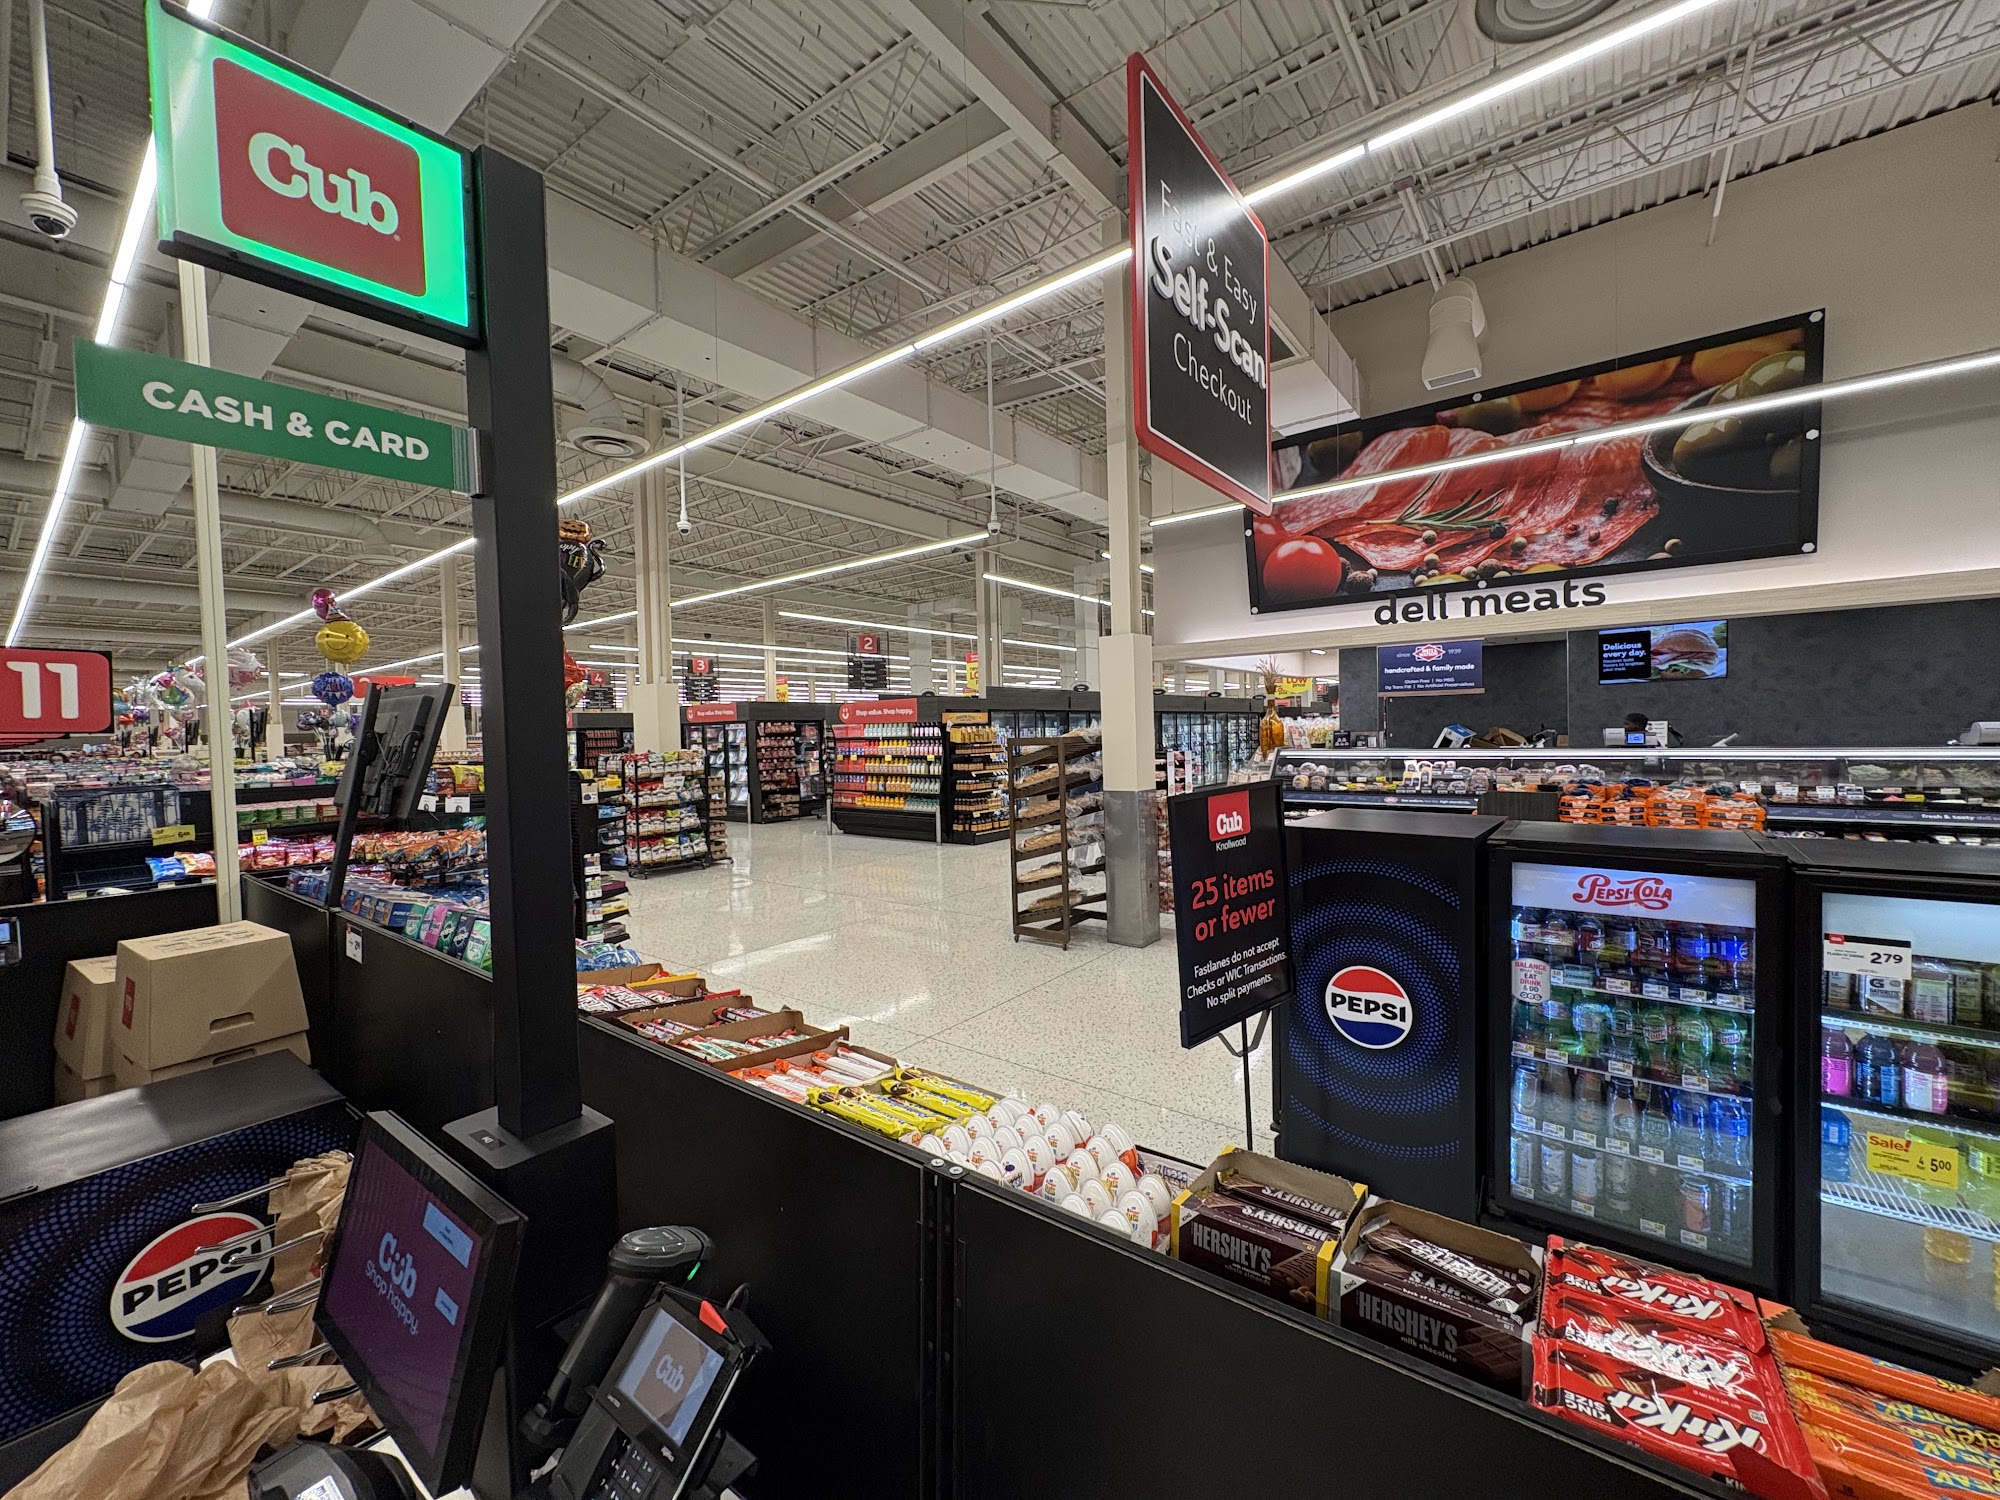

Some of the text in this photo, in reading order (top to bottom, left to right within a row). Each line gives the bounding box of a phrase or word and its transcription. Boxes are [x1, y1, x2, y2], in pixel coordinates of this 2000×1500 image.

[247, 131, 399, 235] Cub
[1160, 179, 1257, 325] Fast & Easy
[1152, 235, 1266, 389] Self-Scan
[1173, 332, 1252, 425] Checkout
[141, 380, 430, 462] CASH & CARD
[1374, 580, 1606, 625] deli meats
[864, 638, 873, 650] 2
[595, 674, 603, 682] 4
[696, 660, 705, 670] 3
[1384, 665, 1424, 674] handcrafted
[6, 661, 79, 719] 11
[322, 682, 346, 692] PARTY
[1216, 811, 1243, 834] Cub
[1216, 836, 1246, 851] Knollwood
[1192, 870, 1274, 910] 25 items
[1195, 898, 1275, 941] or fewer
[1194, 937, 1280, 978] Fastlanes do not accept
[1515, 961, 1547, 971] BALANCE
[1869, 952, 1903, 964] 279
[1187, 951, 1287, 999] Checks or WIC Transactions.
[1206, 973, 1273, 1009] No split payments.
[1331, 992, 1406, 1022] PEPSI
[1869, 1135, 1911, 1152] Sale!
[1919, 1156, 1924, 1165] 4
[1930, 1158, 1951, 1172] 500
[1261, 1186, 1345, 1219] HERSHEY'S
[1182, 1213, 1192, 1222] KING
[1242, 1205, 1330, 1242] HERSHEY'S
[1193, 1222, 1272, 1274] HERSHEY'S
[365, 1260, 387, 1296] Shop
[1344, 1280, 1357, 1291] KING
[1564, 1279, 1602, 1294] KING
[1565, 1272, 1598, 1288] SIZE
[387, 1283, 418, 1335] happy.
[1402, 1288, 1418, 1298] back
[1428, 1298, 1451, 1309] carton
[1359, 1292, 1458, 1353] HERSHEY'S
[1401, 1335, 1457, 1362] milk chocolate
[656, 1354, 685, 1393] Cub
[1564, 1389, 1605, 1412] SIZE
[1564, 1398, 1611, 1422] KING
